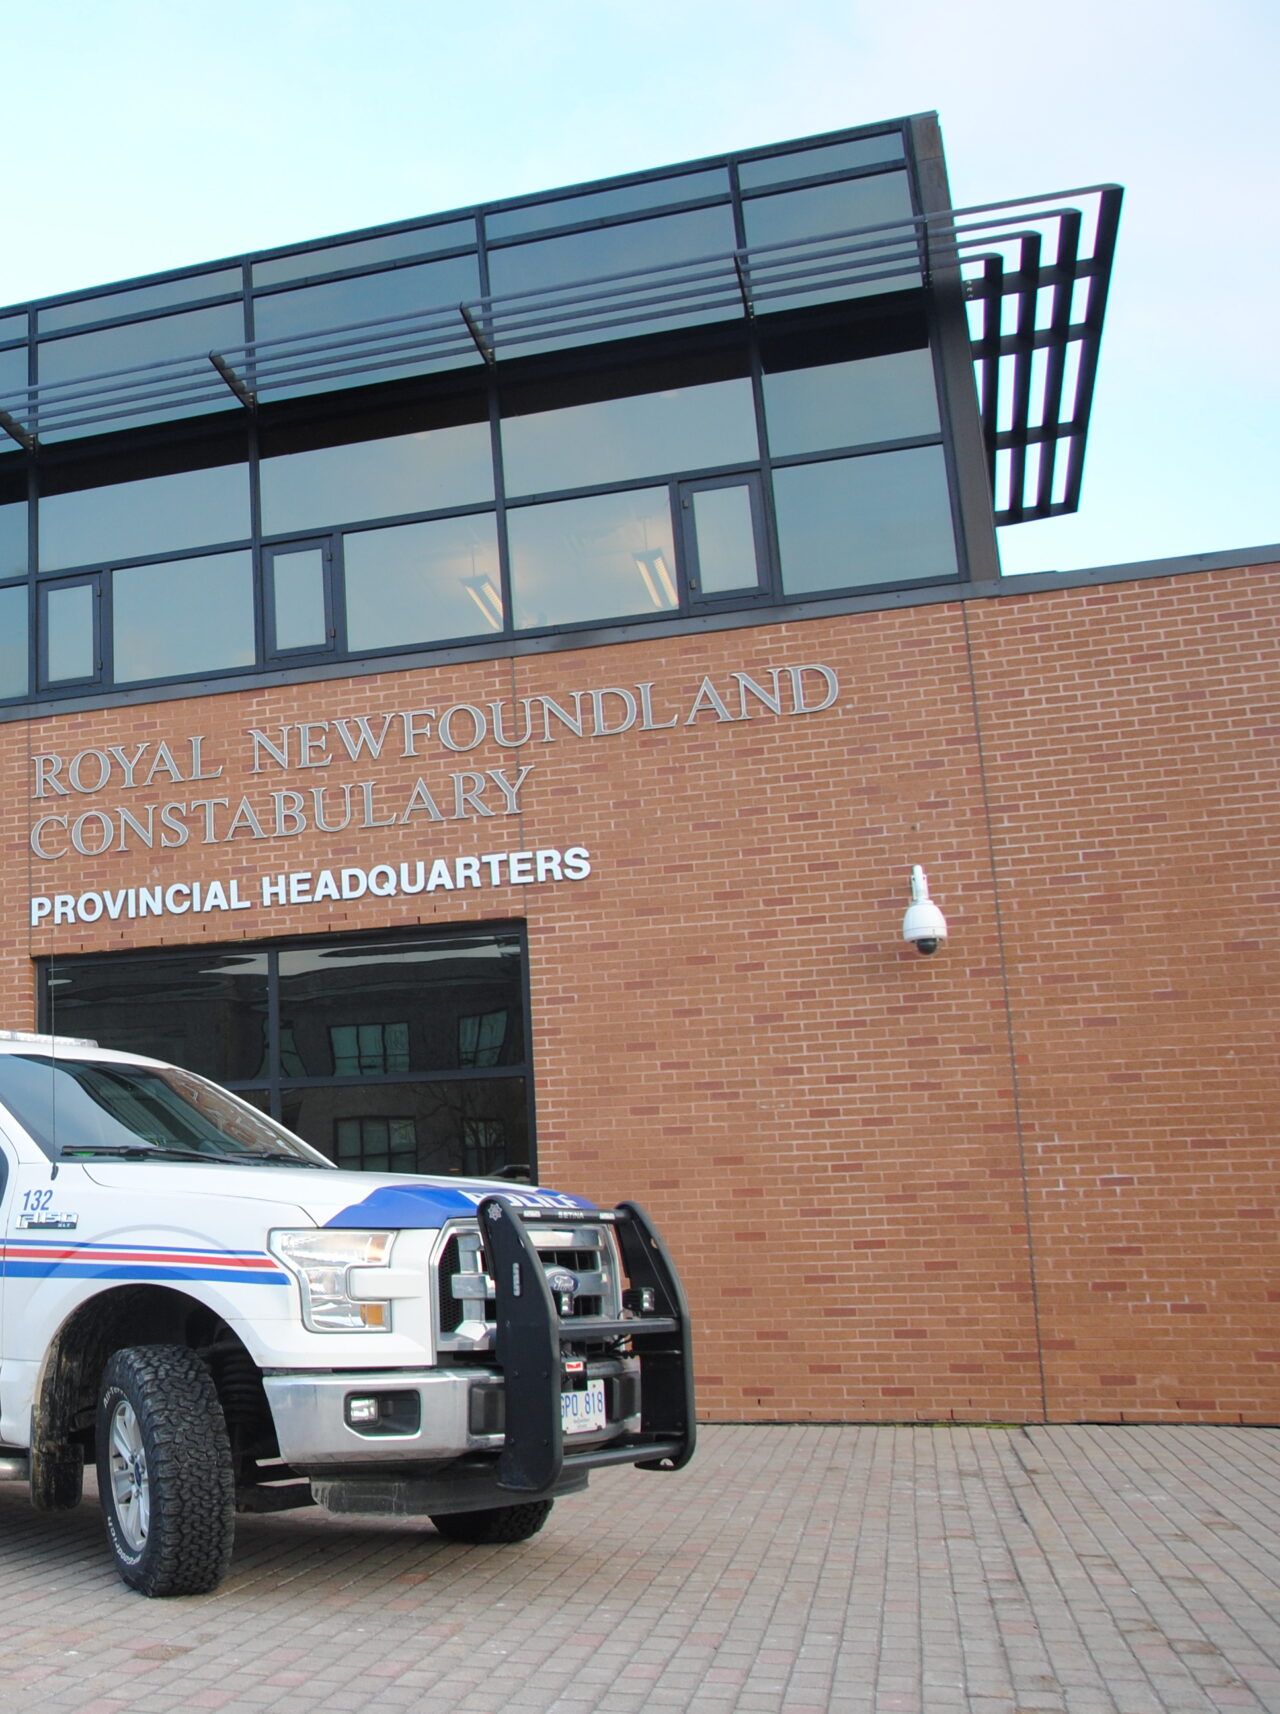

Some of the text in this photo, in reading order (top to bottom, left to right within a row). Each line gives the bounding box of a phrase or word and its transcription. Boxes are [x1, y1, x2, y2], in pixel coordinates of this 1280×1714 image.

[31, 664, 839, 799] ROYAL NEWFOUNDLAND
[31, 765, 535, 860] CONSTABULARY
[31, 846, 591, 927] PROVINCIAL HEADQUARTERS
[24, 1189, 53, 1211] 132
[584, 1391, 604, 1415] 818
